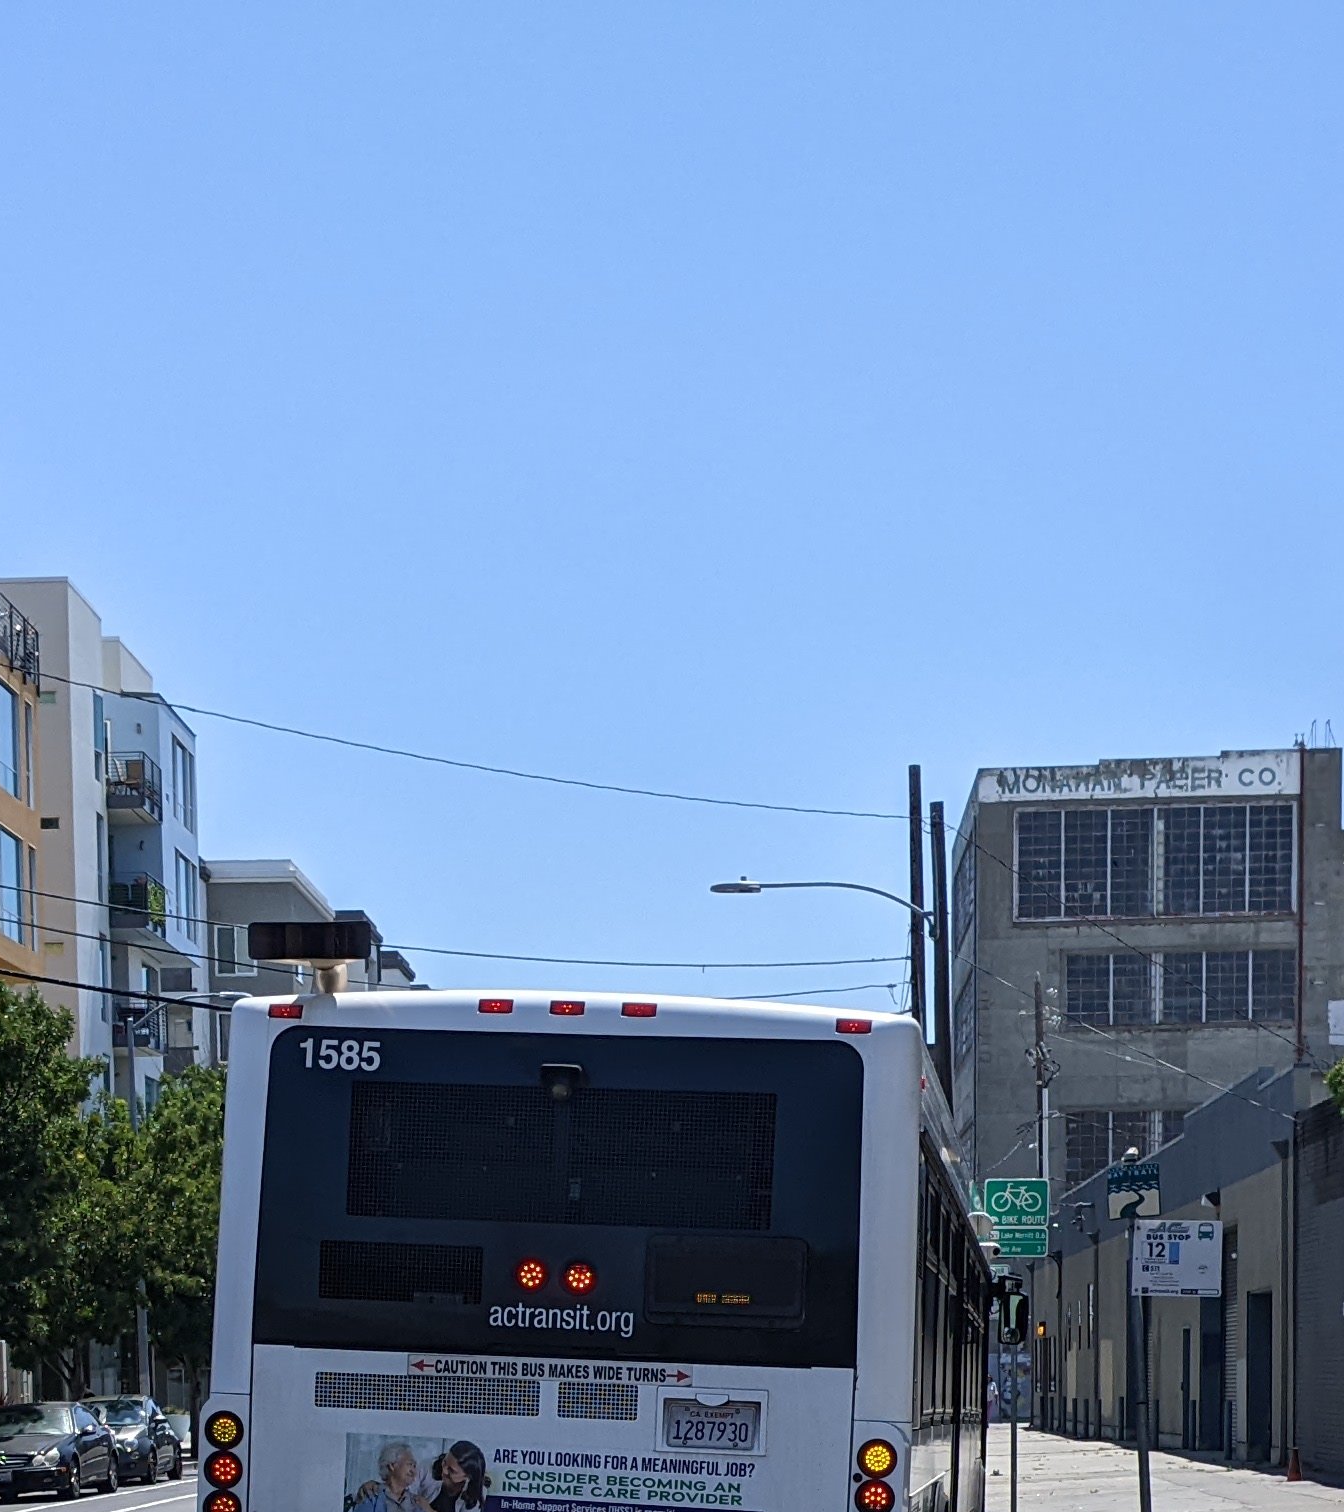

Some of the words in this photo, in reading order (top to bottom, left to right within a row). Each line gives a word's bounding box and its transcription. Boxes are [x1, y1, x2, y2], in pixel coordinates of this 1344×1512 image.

[1238, 766, 1282, 787] CO.
[300, 1038, 381, 1072] 1585
[1001, 1215, 1018, 1224] BIKE
[1021, 1215, 1045, 1224] ROUTE
[1146, 1233, 1164, 1241] BUS
[1168, 1233, 1191, 1241] STOP
[1147, 1242, 1166, 1258] 12
[489, 1302, 635, 1338] actransit.org
[434, 1359, 487, 1376] CAUTION
[491, 1361, 519, 1377] THIS
[521, 1362, 545, 1378] BUS
[548, 1363, 589, 1380] MAKES
[593, 1365, 623, 1381] WIDE
[626, 1367, 667, 1383] TURNS
[704, 1410, 734, 1419] EXEMPT
[672, 1419, 749, 1443] 1287930
[494, 1449, 521, 1465] ARE
[521, 1450, 546, 1467] YOU
[547, 1451, 601, 1469] LOOKING
[605, 1454, 629, 1471] FOR
[630, 1456, 639, 1472] A
[641, 1457, 723, 1476] MEANINGFUL
[723, 1461, 755, 1478] JOB?
[505, 1469, 600, 1485] CONSIDER
[606, 1475, 707, 1492] BECOMING
[713, 1481, 741, 1493] AN
[501, 1499, 535, 1511] In-Home
[536, 1501, 569, 1512] Support
[502, 1481, 584, 1497] IN-HOME
[590, 1486, 640, 1500] CARE
[647, 1490, 742, 1506] PROVIDER
